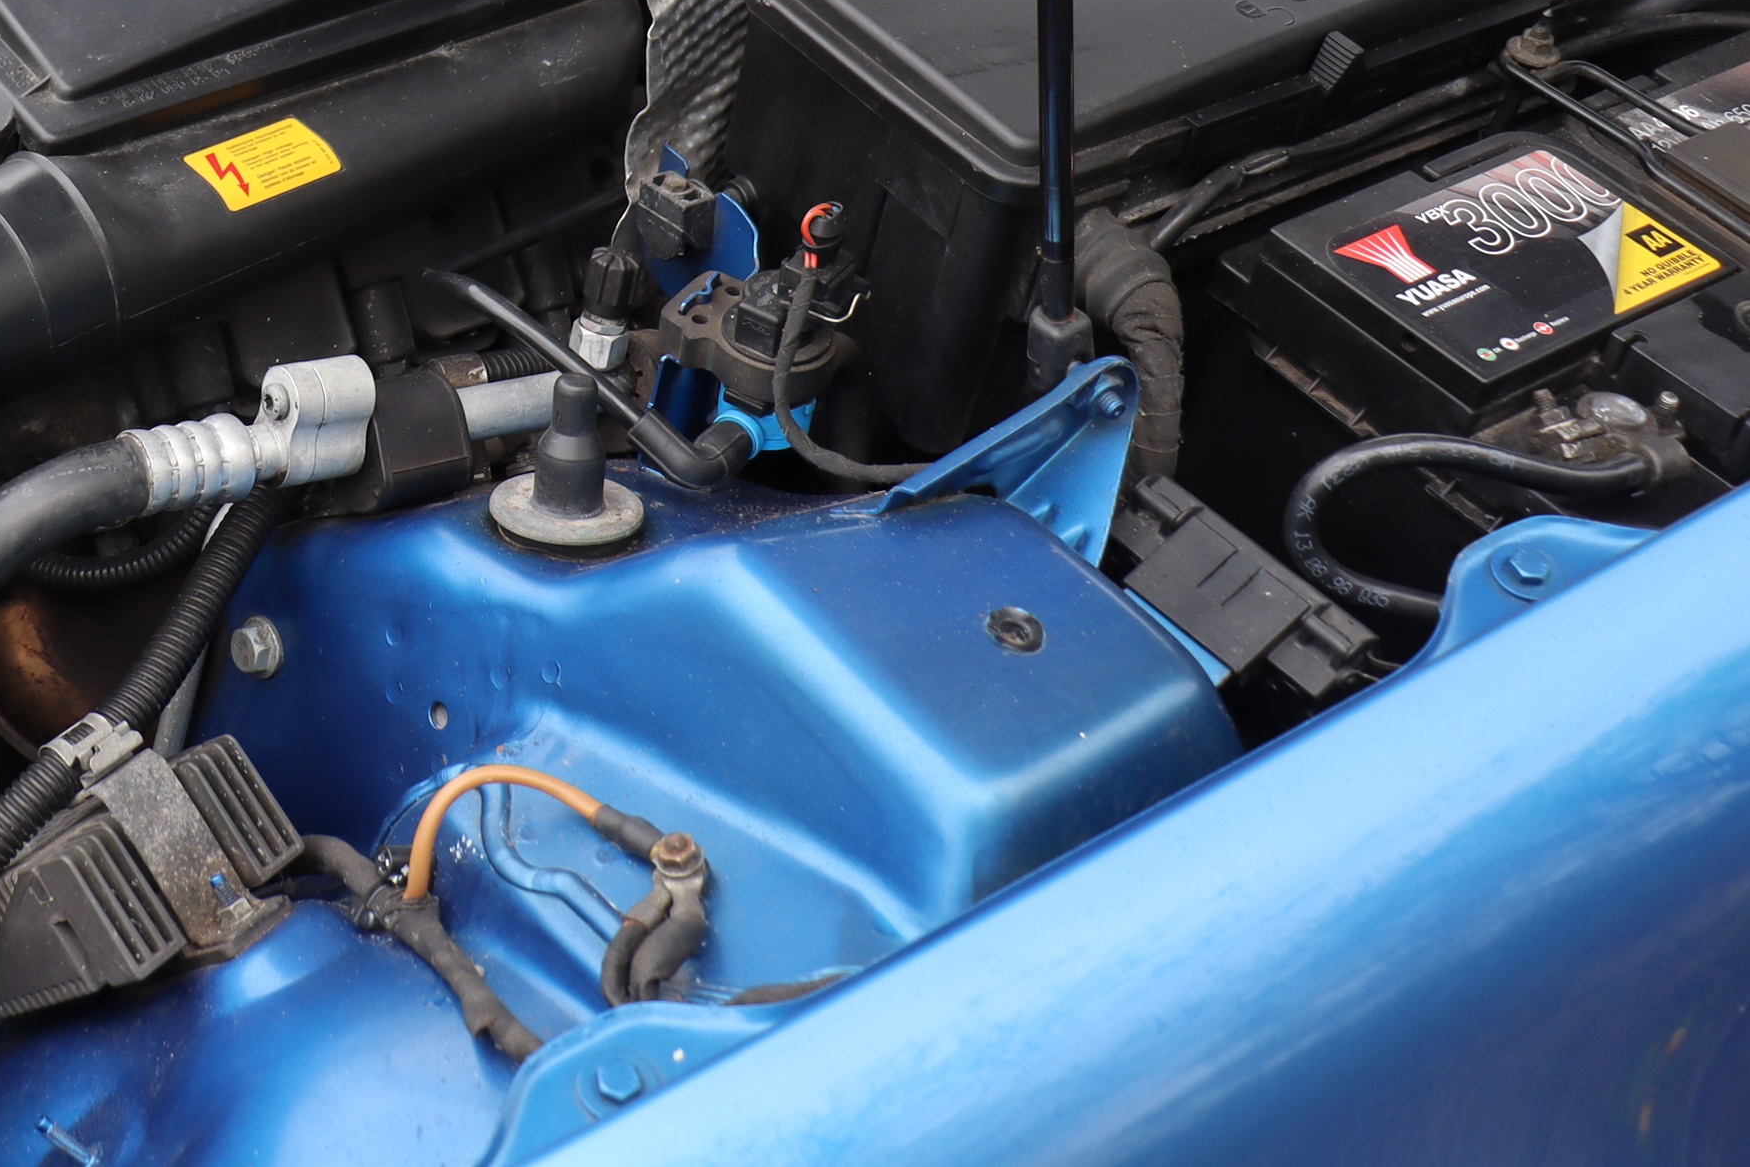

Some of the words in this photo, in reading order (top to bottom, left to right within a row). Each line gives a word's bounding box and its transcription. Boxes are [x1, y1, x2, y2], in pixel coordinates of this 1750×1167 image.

[1415, 205, 1450, 224] YBX
[1641, 230, 1673, 251] AA
[1623, 288, 1632, 296] 4
[1630, 277, 1658, 292] YEAR
[1655, 255, 1705, 281] WARRANTY
[1640, 268, 1656, 277] NO
[1655, 249, 1697, 271] QUIBBLE
[1396, 268, 1477, 306] YUASA
